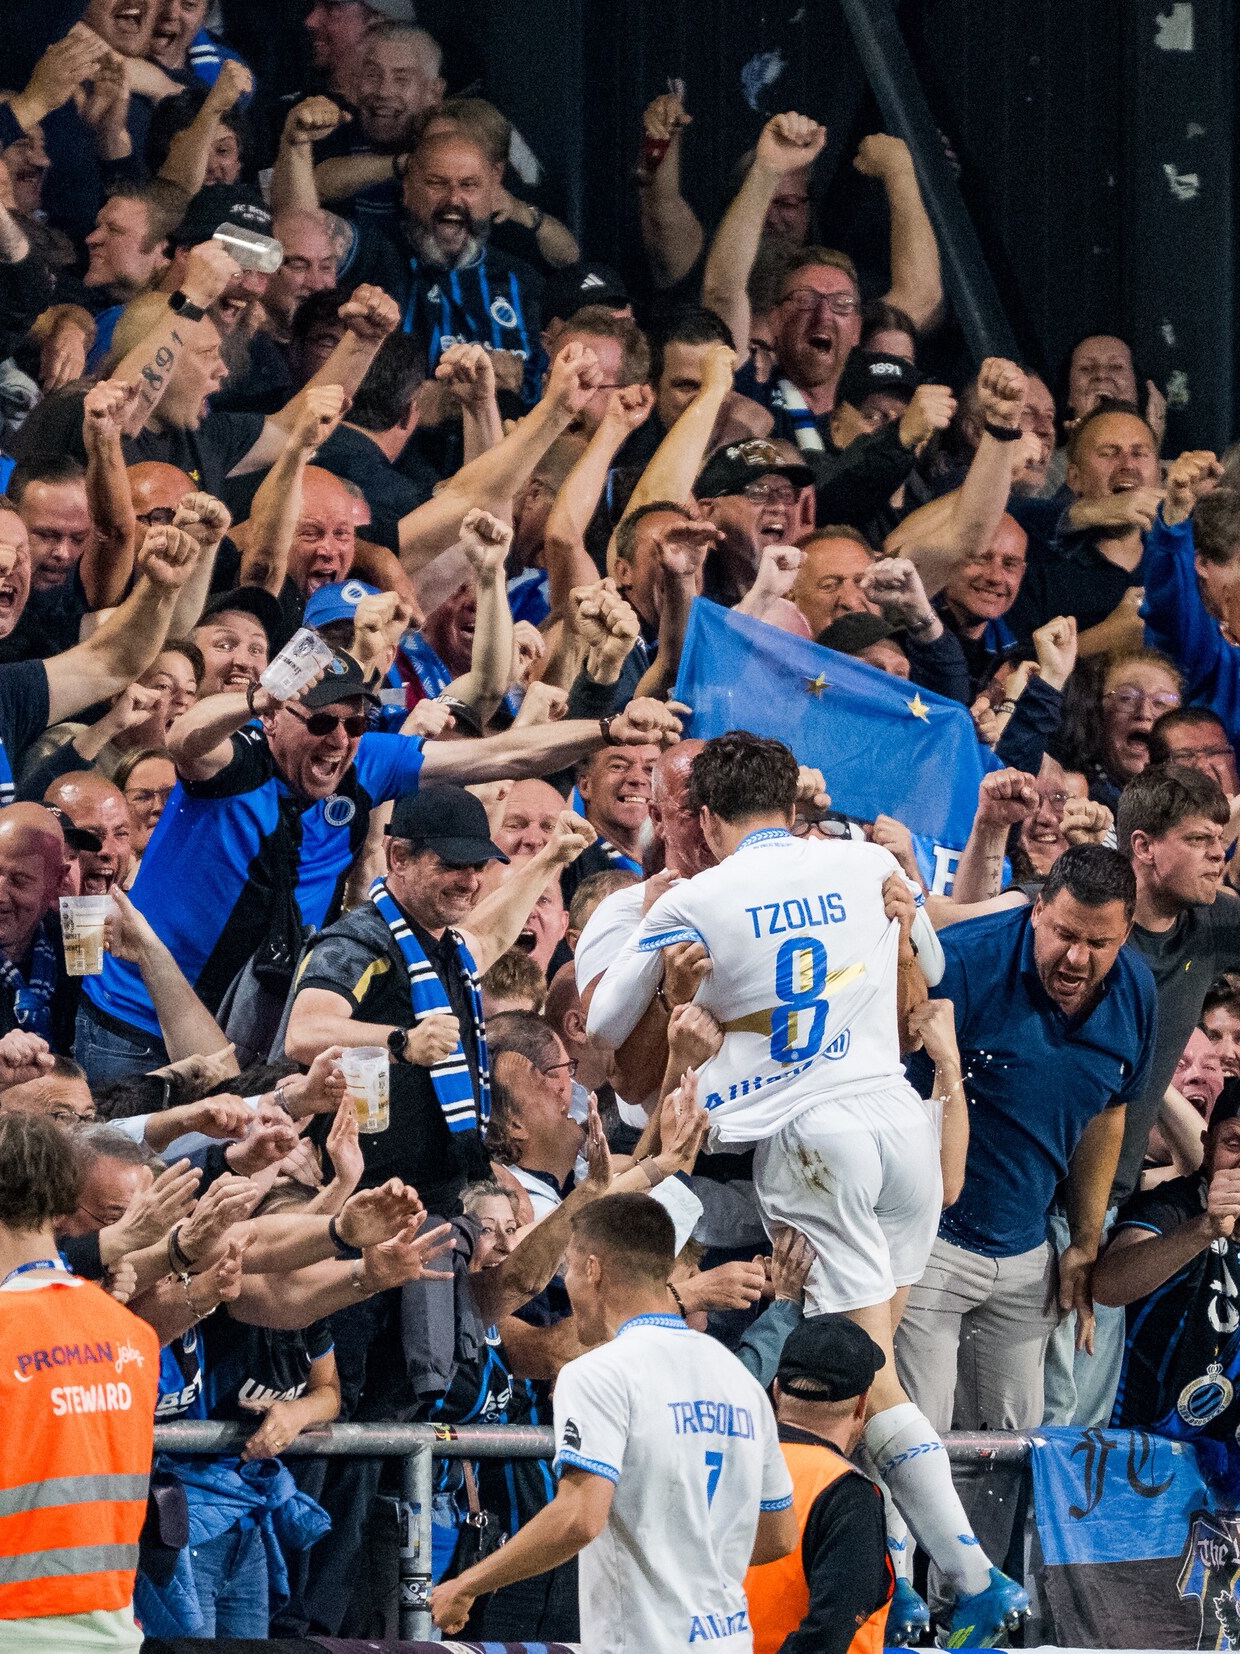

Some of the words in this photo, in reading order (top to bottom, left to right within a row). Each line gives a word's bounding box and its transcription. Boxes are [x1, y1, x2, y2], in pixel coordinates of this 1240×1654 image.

[139, 329, 184, 404] 1891
[869, 362, 902, 377] 1891
[745, 892, 847, 938] TZOLIS
[770, 936, 830, 1063] 8
[17, 1341, 113, 1374] PROMAN
[51, 1382, 132, 1416] STEWARD
[667, 1400, 755, 1440] TRESOLDI
[705, 1450, 723, 1513] 7
[1197, 1537, 1228, 1571] The
